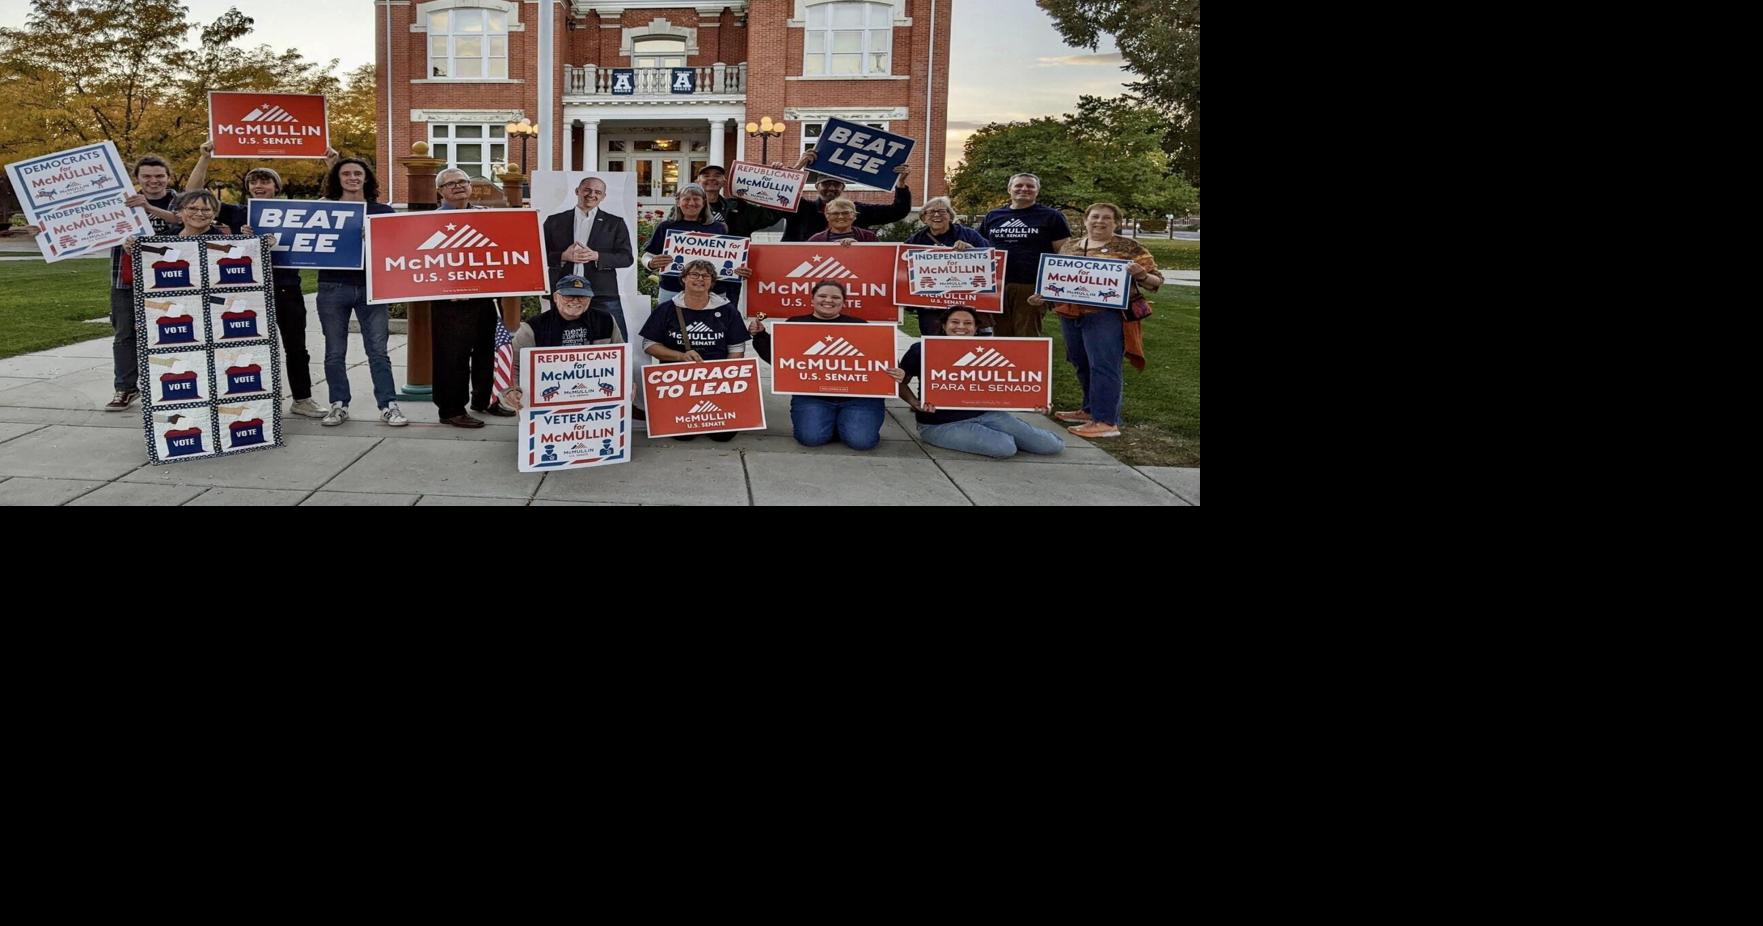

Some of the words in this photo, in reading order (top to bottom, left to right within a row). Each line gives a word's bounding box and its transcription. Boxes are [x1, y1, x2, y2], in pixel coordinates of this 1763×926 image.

[614, 75, 632, 89] A
[673, 73, 692, 87] A
[218, 124, 321, 136] McMULLIN
[238, 137, 260, 145] U.S.
[263, 137, 303, 145] SENATE
[828, 126, 906, 158] BEAT
[24, 151, 100, 175] DEMOCRATS
[828, 147, 887, 175] LEE
[32, 164, 104, 188] McMULLIN
[737, 164, 800, 180] REPUBLICANS
[736, 177, 794, 192] McMULLIN
[44, 198, 123, 221] INDEPENDENTS
[53, 210, 126, 235] McMULLIN
[258, 208, 355, 230] BEAT
[271, 232, 340, 253] LEE
[674, 236, 726, 248] WOMEN
[674, 246, 738, 260] McMULLIN
[916, 252, 988, 260] INDEPENDENTS
[385, 250, 530, 272] McMULLIN
[1048, 258, 1122, 272] DEMOCRATS
[161, 270, 183, 278] VOTE
[413, 272, 442, 283] U.S.
[448, 270, 504, 281] SENATE
[919, 265, 986, 274] McMULLIN
[1048, 272, 1118, 286] McMULLIN
[758, 282, 886, 296] McMLIN
[781, 298, 806, 306] U.S.
[164, 326, 188, 334] VOTE
[230, 321, 250, 329] VOTE
[538, 351, 618, 364] REPUBLICANS
[780, 358, 888, 372] McMULLIN
[234, 375, 255, 384] VOTE
[541, 368, 614, 381] McMULLIN
[648, 364, 754, 384] COURAGE
[800, 372, 821, 380] U.S.
[825, 374, 868, 382] SENATE
[931, 369, 1042, 382] McMULLIN
[168, 382, 192, 391] VOTE
[656, 384, 684, 398] TO
[690, 380, 748, 396] LEAD
[970, 384, 984, 392] EL
[988, 384, 1042, 392] SENADO
[544, 410, 612, 424] VETERANS
[675, 412, 736, 424] McMULLIN
[702, 420, 726, 428] SENATE
[236, 429, 257, 438] VOTE
[541, 428, 614, 443] McMULLIN
[172, 438, 195, 446] VOTE
